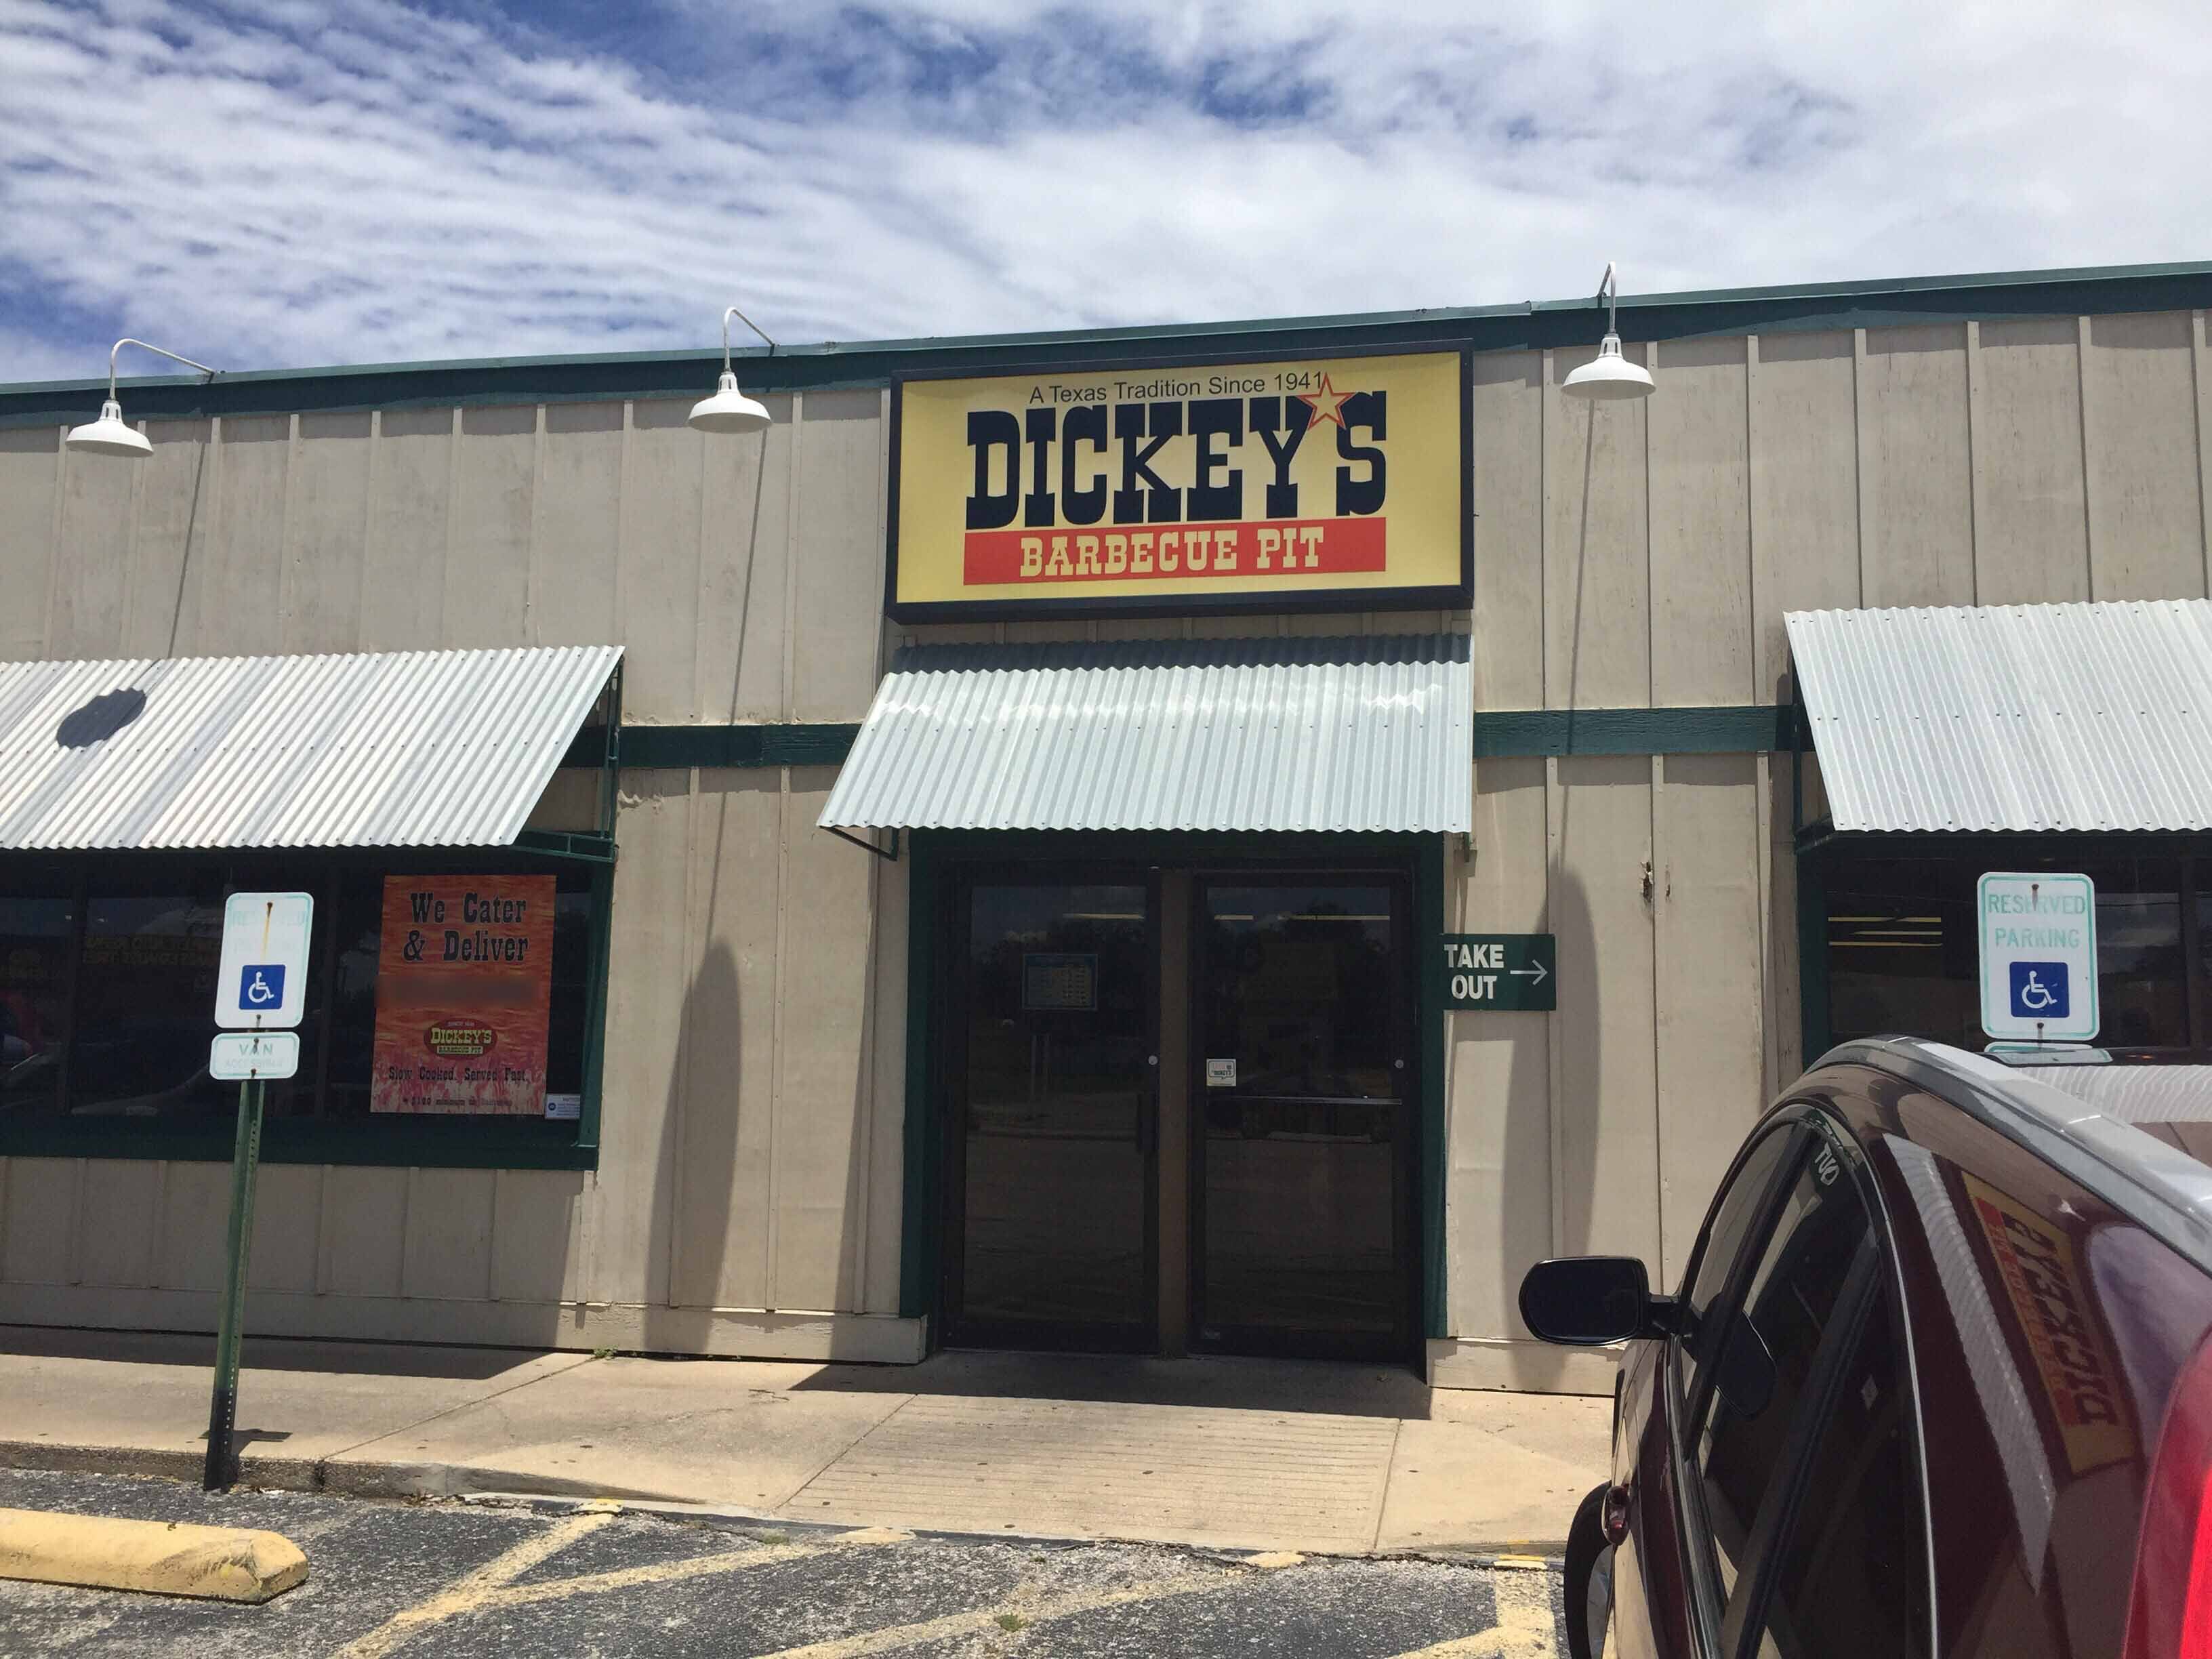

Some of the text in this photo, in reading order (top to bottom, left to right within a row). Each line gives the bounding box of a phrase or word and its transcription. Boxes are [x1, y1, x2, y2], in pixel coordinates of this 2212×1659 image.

[1029, 371, 1322, 404] A Texas Tradition Since 1941
[1020, 526, 1324, 578] BARBECUE PIT
[409, 892, 527, 923] We Cater
[403, 929, 529, 962] & Deliver
[1994, 928, 2080, 949] PARKING
[1443, 943, 1504, 968] TAKE
[1451, 975, 1498, 1000] OUT
[239, 1043, 273, 1056] VAN
[389, 1066, 413, 1080] Slow
[464, 1067, 497, 1081] Served
